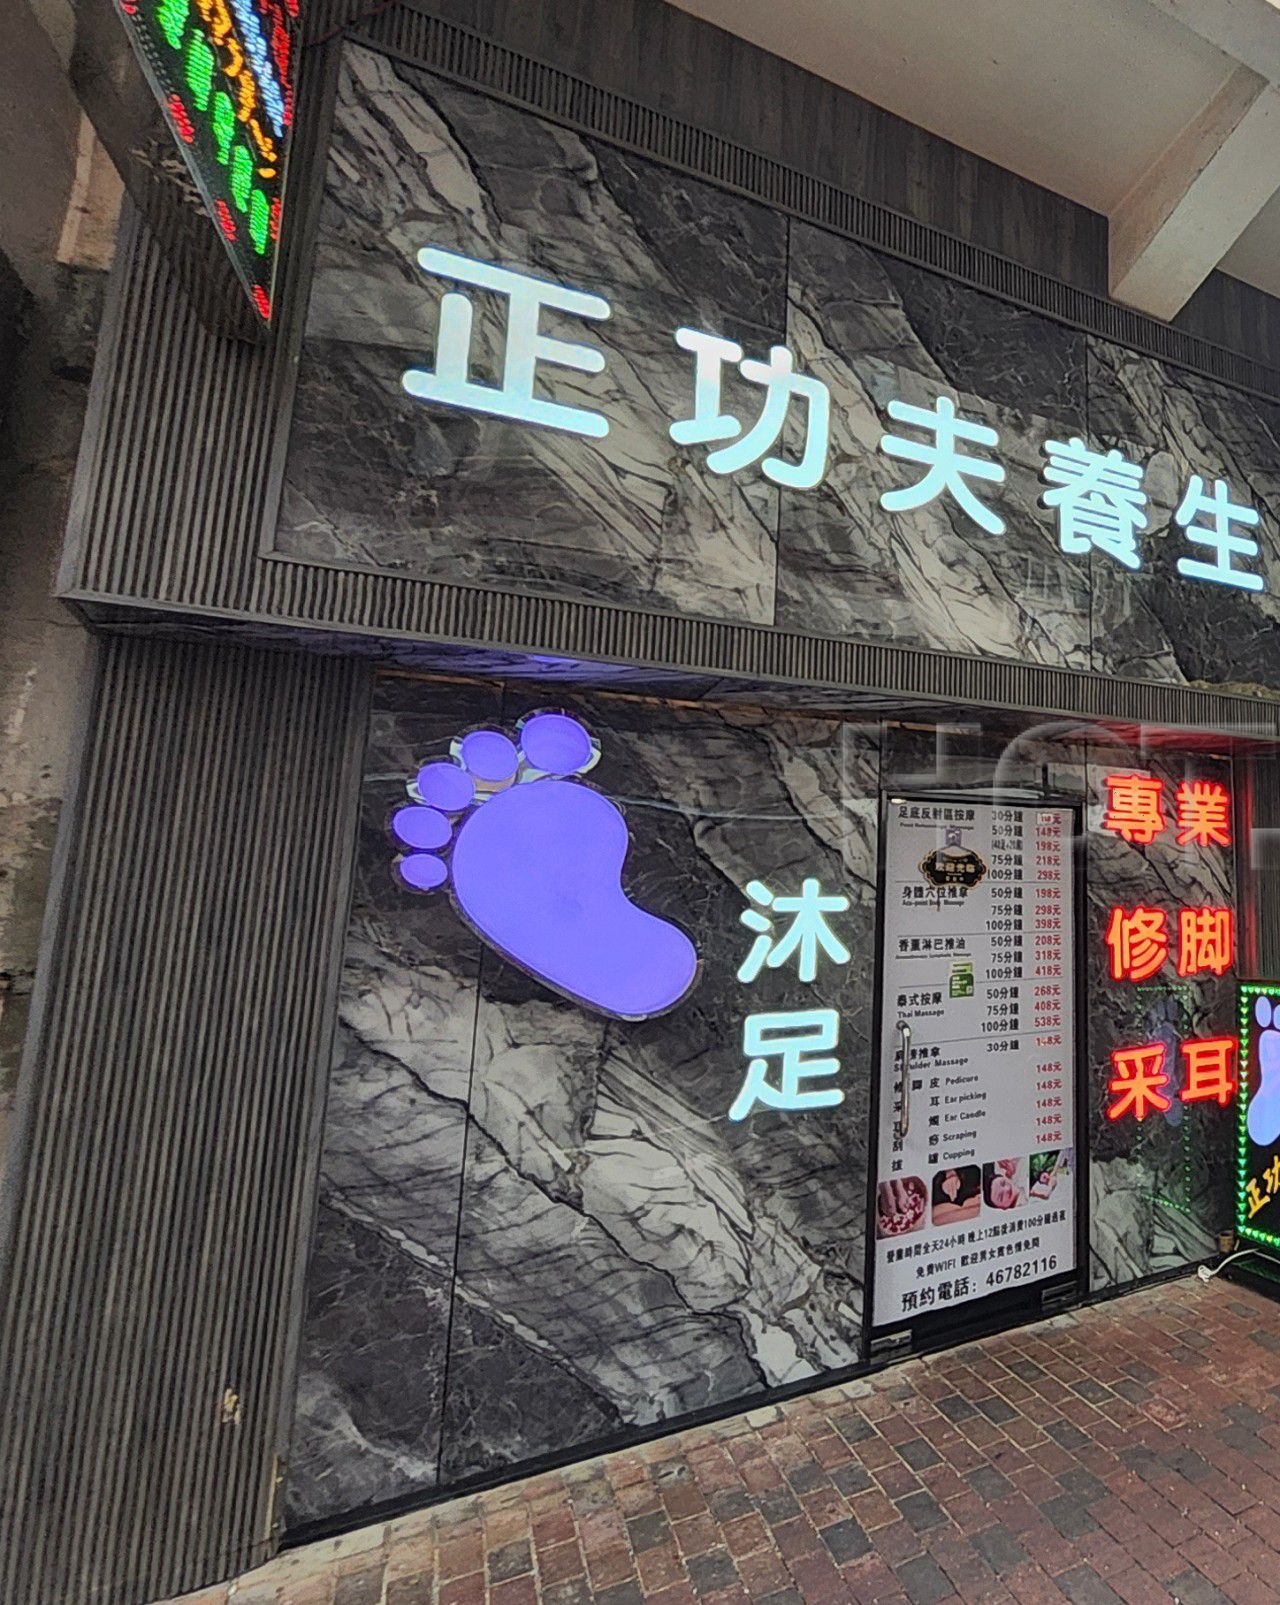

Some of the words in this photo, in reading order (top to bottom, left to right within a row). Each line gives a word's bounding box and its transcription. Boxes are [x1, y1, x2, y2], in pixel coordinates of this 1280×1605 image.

[401, 246, 1265, 592] 正功夫養生
[1103, 773, 1232, 848] 專業
[992, 825, 1023, 837] 50分鐘
[1036, 841, 1061, 852] 198元
[991, 855, 1023, 866] 75分鐘
[1036, 856, 1061, 867] 218元
[987, 868, 1023, 880] 100分鐘
[1037, 870, 1061, 881] 298元
[991, 887, 1022, 898] 50分鐘
[1035, 888, 1061, 899] 198元
[991, 904, 1022, 916] 75分鐘
[1035, 904, 1061, 915] 298元
[986, 919, 1022, 931] 100分鐘
[1035, 919, 1061, 930] 398元
[991, 936, 1022, 947] 50分鐘
[1035, 935, 1061, 946] 208元
[991, 951, 1022, 963] 75分鐘
[1035, 950, 1061, 961] 318元
[986, 966, 1022, 979] 100分鐘
[1035, 966, 1061, 977] 418元
[986, 986, 1019, 999] 50分鐘
[1034, 985, 1061, 996] 268元
[728, 877, 851, 1122] 沐足
[986, 1003, 1019, 1016] 75分鐘
[1034, 1000, 1061, 1011] 408元
[981, 1018, 1019, 1032] 100分鐘
[1034, 1015, 1061, 1027] 538元
[987, 1040, 1020, 1052] 30分鐘
[934, 1058, 969, 1068] Massage
[945, 1075, 979, 1086] Pedicure
[1036, 1062, 1063, 1074] 148元
[1107, 1037, 1239, 1122] 采耳
[945, 1096, 957, 1105] Ear
[959, 1091, 987, 1104] picking
[1036, 1079, 1063, 1091] 148元
[945, 1112, 957, 1122] Ear
[960, 1109, 986, 1120] Candle
[1036, 1096, 1063, 1109] 148元
[943, 1130, 977, 1143] Scraping
[1036, 1113, 1063, 1126] 148元
[943, 1149, 975, 1161] Cupping
[1036, 1131, 1063, 1144] 148元
[986, 1255, 1057, 1287] 46782116
